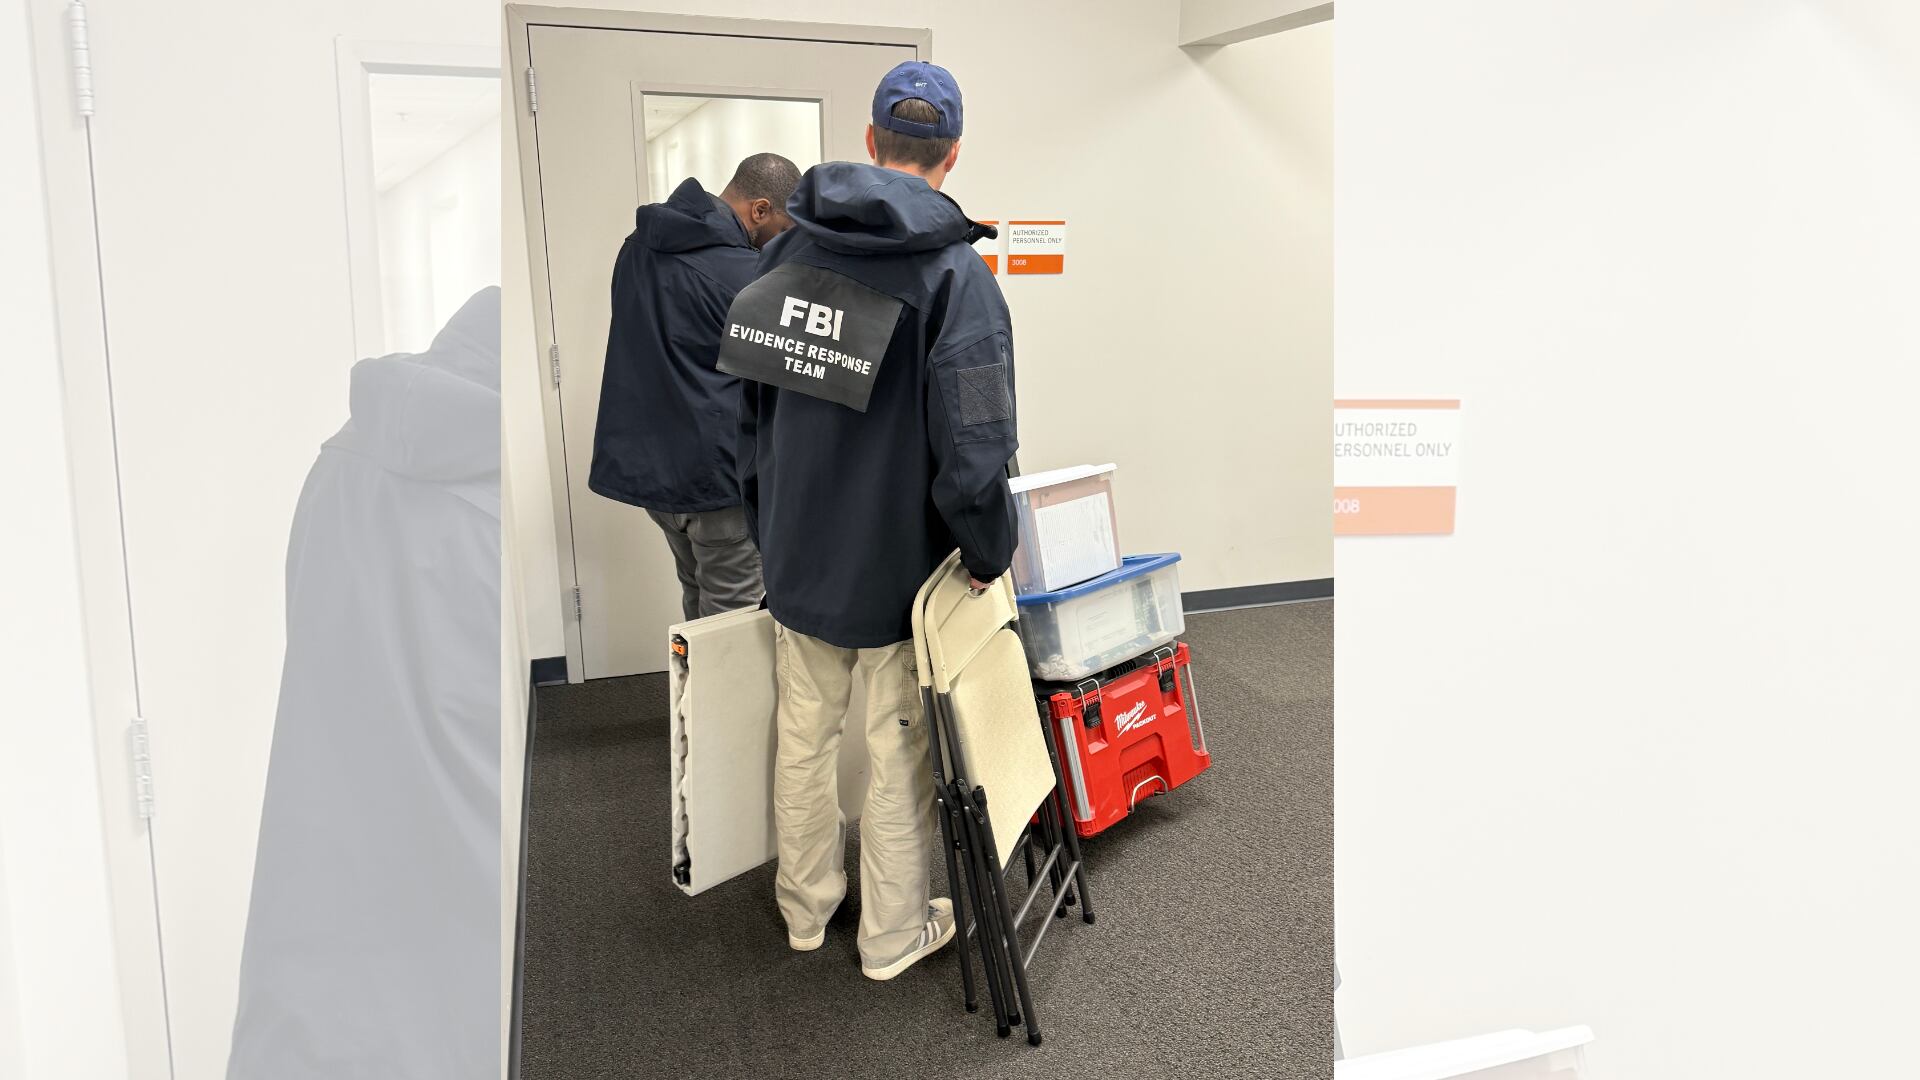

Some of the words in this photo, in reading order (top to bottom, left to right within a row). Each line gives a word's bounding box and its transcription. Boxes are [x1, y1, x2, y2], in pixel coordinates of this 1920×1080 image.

[779, 295, 845, 342] FBI
[729, 323, 806, 355] EVIDENCE
[807, 344, 872, 375] RESPONSE
[784, 356, 826, 380] TEAM
[1334, 422, 1418, 437] UTHORIZED
[1334, 442, 1412, 457] ERSONNEL
[1415, 442, 1453, 457] ONLY
[1334, 498, 1361, 514] 008
